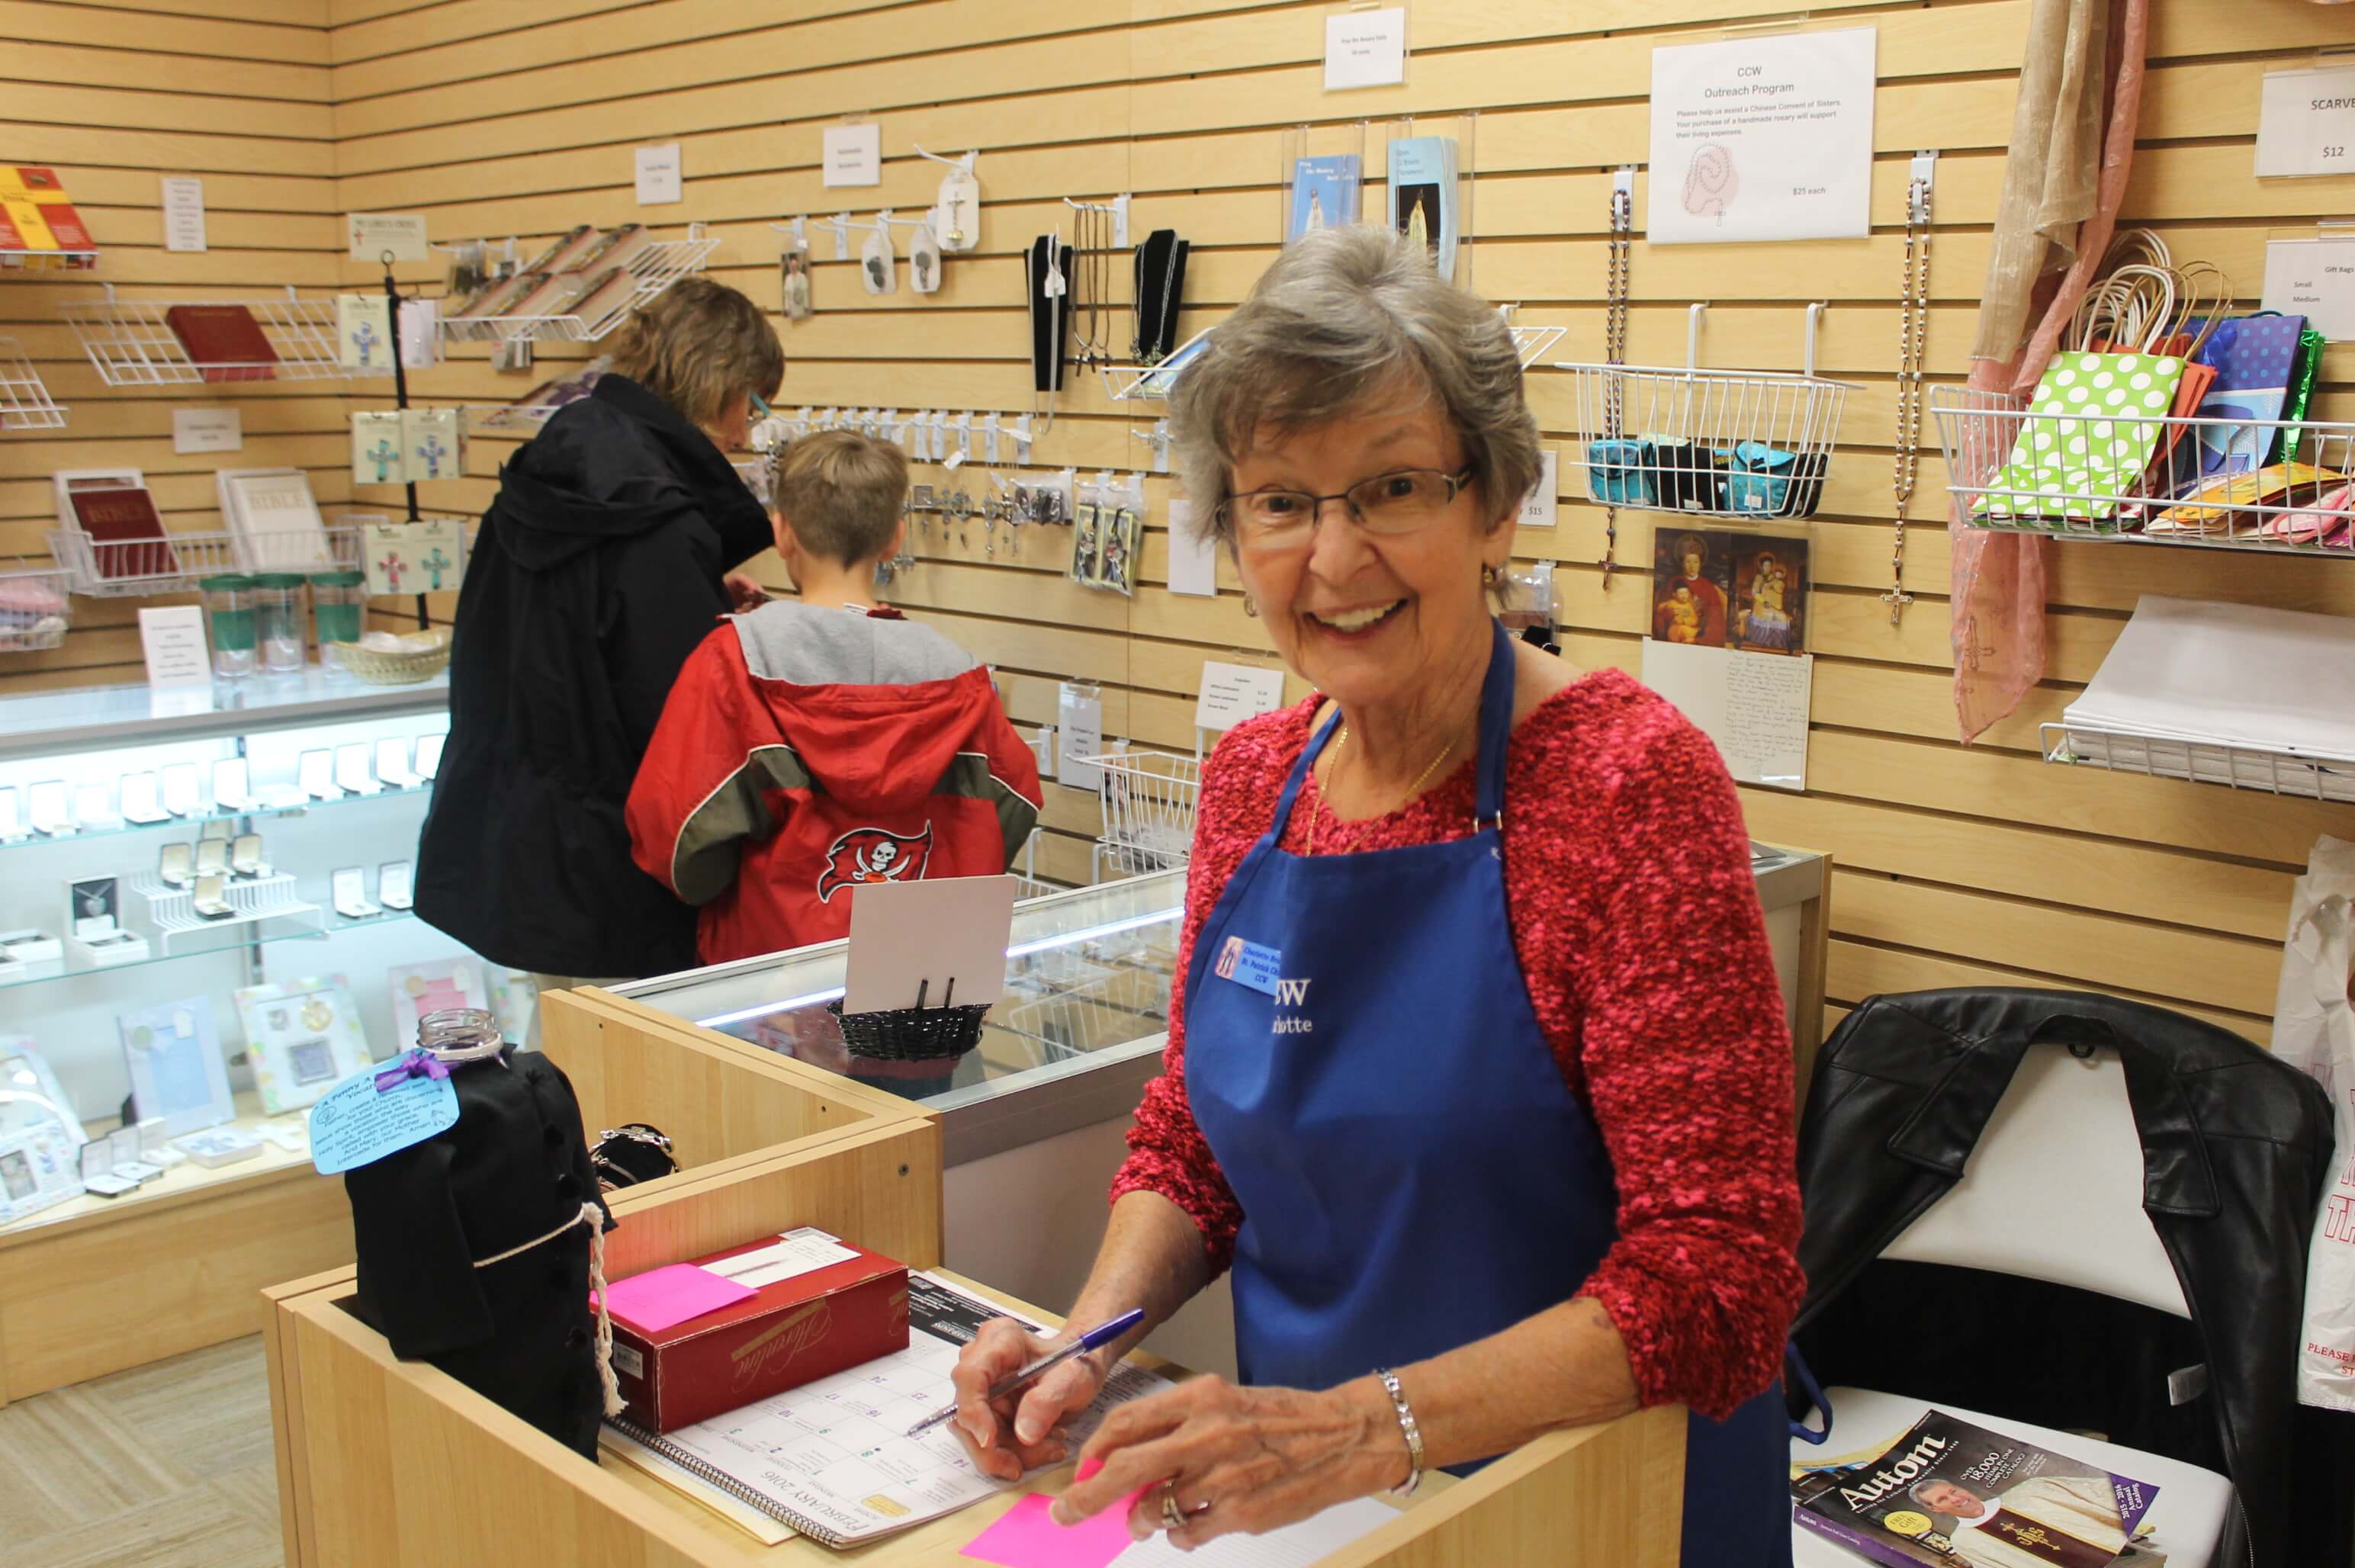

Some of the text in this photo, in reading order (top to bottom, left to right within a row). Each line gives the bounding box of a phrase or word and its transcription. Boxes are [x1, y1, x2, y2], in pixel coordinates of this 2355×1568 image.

[1737, 66, 1762, 78] CCW
[1704, 83, 1794, 98] Outreach Program
[1699, 108, 1714, 117] help
[1749, 104, 1777, 112] Chinese
[1778, 102, 1807, 111] Convent
[1676, 120, 1691, 129] Your
[1692, 119, 1722, 128] purchase
[1737, 115, 1772, 124] handmade
[1774, 114, 1795, 123] rosary
[1810, 111, 1836, 120] support
[1692, 130, 1710, 140] living
[2322, 146, 2344, 159] $12
[1792, 186, 1826, 196] $25 each
[251, 491, 308, 510] BIBLE
[1528, 506, 1543, 516] $15
[1255, 973, 1270, 984] CCW
[333, 1082, 360, 1102] Penny
[347, 1084, 374, 1098] Vocat
[349, 1100, 370, 1113] create
[358, 1104, 374, 1116] your
[335, 1123, 352, 1134] show
[354, 1112, 373, 1124] those
[374, 1104, 389, 1114] who
[390, 1099, 403, 1107] are
[350, 1116, 378, 1132] vocation
[380, 1110, 393, 1118] the
[357, 1117, 389, 1136] empower
[390, 1109, 410, 1120] those
[413, 1104, 429, 1112] who
[341, 1136, 361, 1150] called
[363, 1129, 378, 1139] with
[380, 1122, 395, 1133] your
[344, 1145, 358, 1155] And
[732, 1305, 831, 1393] Florentine
[2307, 1342, 2350, 1362] PLEASE
[870, 1376, 888, 1384] 24
[866, 1409, 882, 1419] 16
[953, 1458, 970, 1468] 14
[1970, 1452, 2000, 1481] 18,000
[1984, 1448, 2015, 1481] ITEMS IN ONE
[2002, 1452, 2026, 1480] CATALOG!
[761, 1470, 796, 1492] 2016
[1839, 1435, 1946, 1511] Autom
[1907, 1465, 1936, 1488] Community
[1960, 1466, 1977, 1480] OVER
[1986, 1462, 2010, 1489] COMPLETE
[2115, 1484, 2125, 1500] 2016
[2122, 1486, 2137, 1511] Annual
[2132, 1483, 2143, 1509] Catalog
[789, 1489, 870, 1531] FEBRUARY
[2119, 1503, 2130, 1519] 2015
[1799, 1513, 1817, 1526] Autom
[1889, 1513, 1907, 1526] FREE
[1899, 1516, 1917, 1529] Gift
